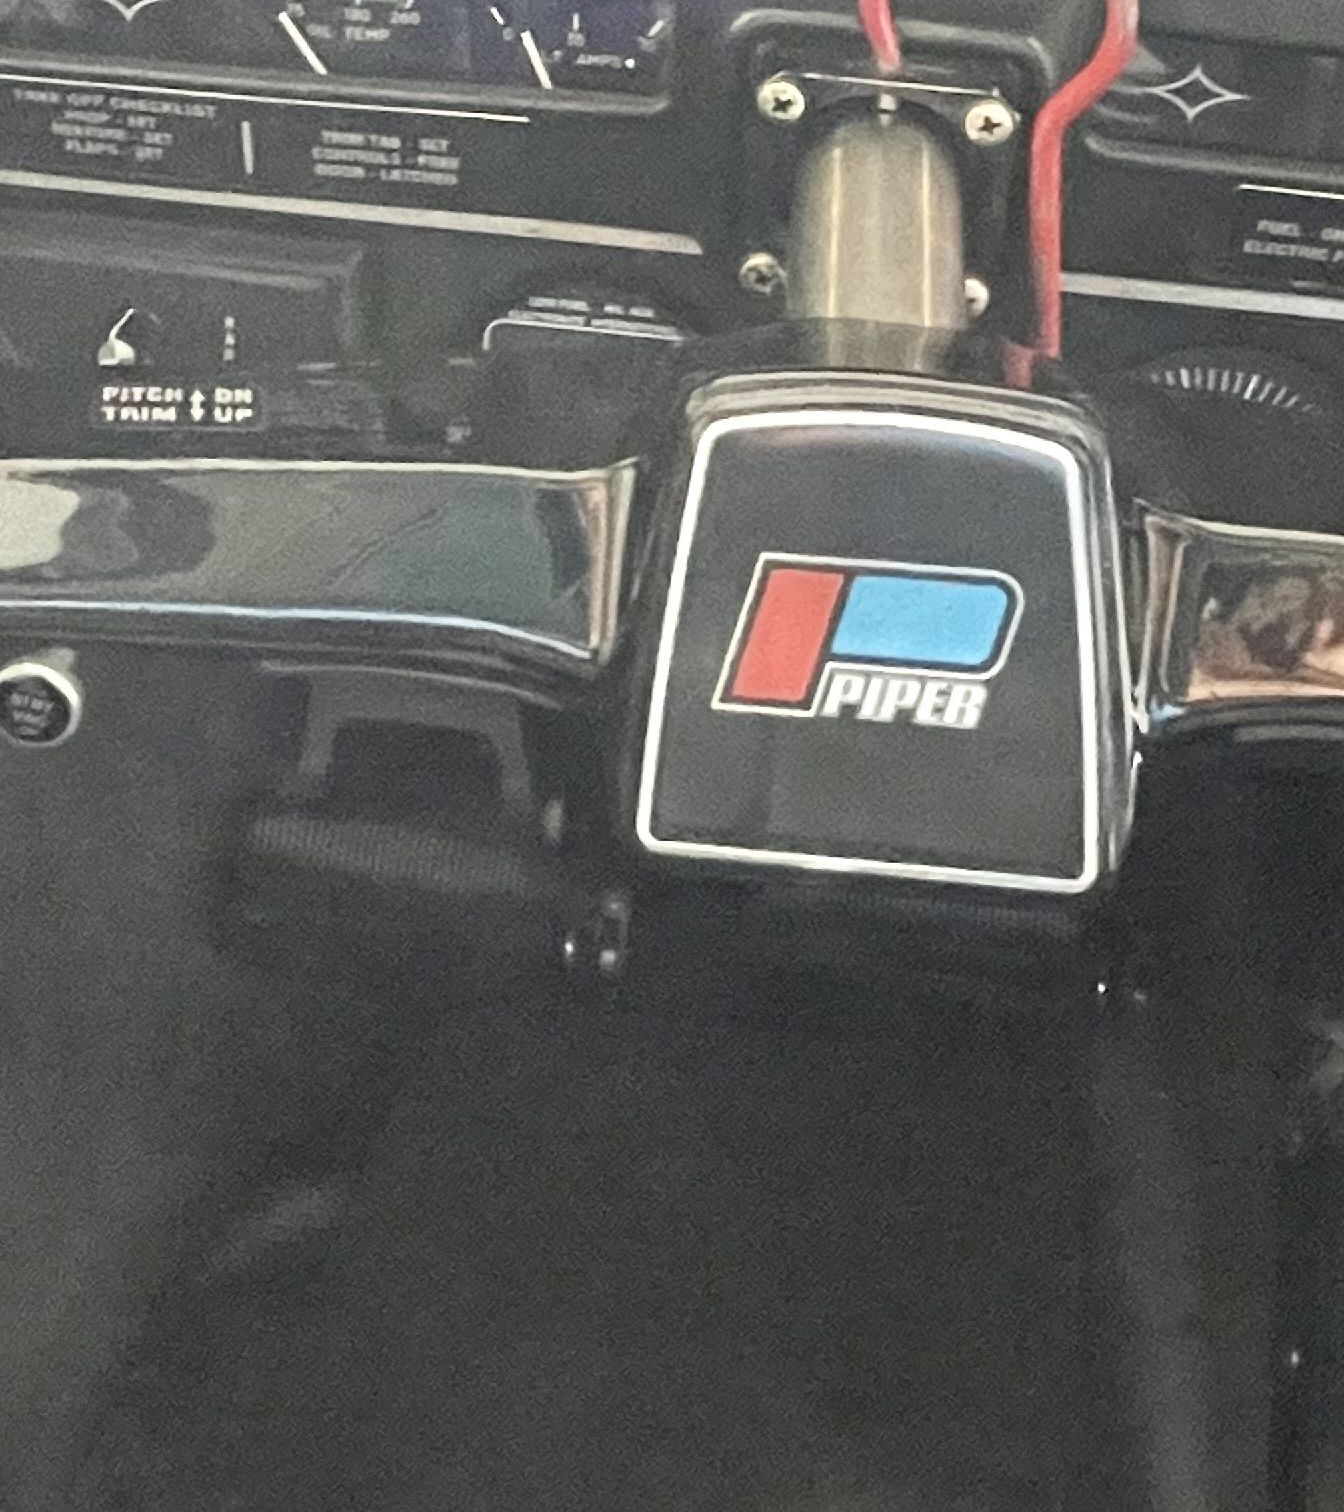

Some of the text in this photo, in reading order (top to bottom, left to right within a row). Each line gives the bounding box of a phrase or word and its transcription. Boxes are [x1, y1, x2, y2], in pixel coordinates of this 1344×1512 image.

[102, 386, 253, 403] PITCH DN
[101, 406, 253, 423] TRIM UP
[819, 672, 988, 730] PIPER
